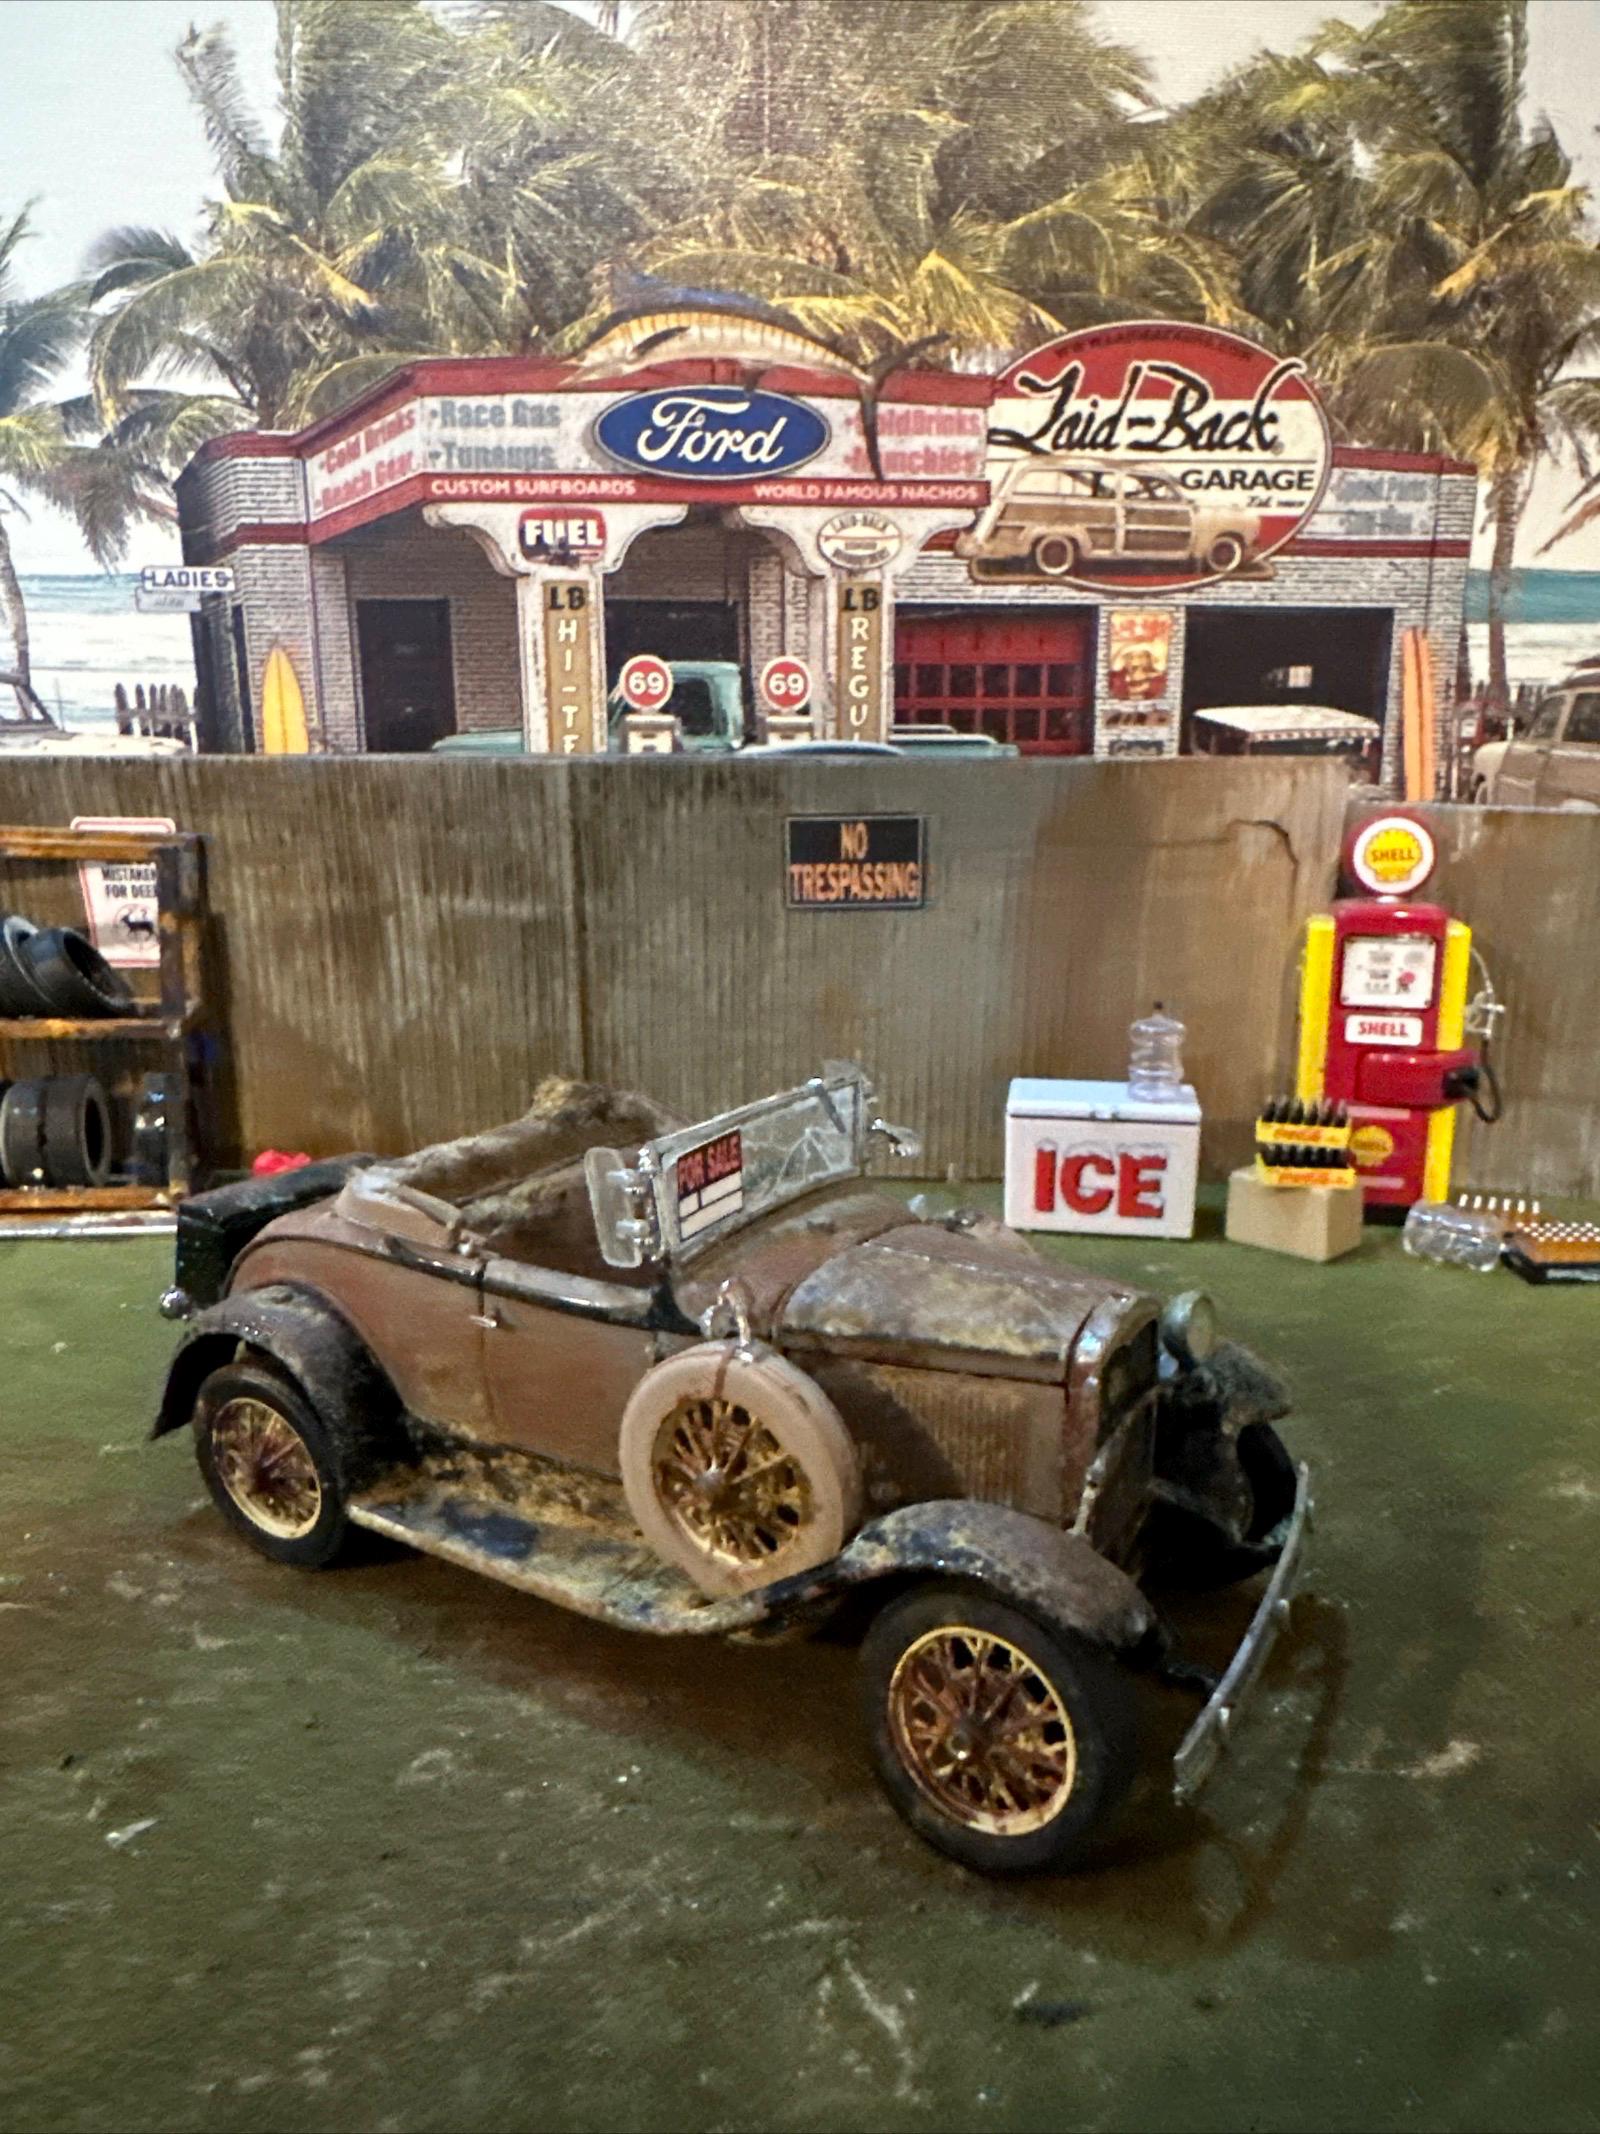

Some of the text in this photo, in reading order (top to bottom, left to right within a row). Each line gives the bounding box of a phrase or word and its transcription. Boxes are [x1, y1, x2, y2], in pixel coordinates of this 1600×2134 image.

[440, 398, 561, 428] Race Gas
[986, 361, 1305, 456] Laid-Back
[637, 397, 787, 464] Ford
[431, 479, 636, 496] CUSTOM SURFBOARDS
[753, 484, 979, 501] WORLD FAMOUS NACHOS
[1180, 469, 1315, 491] GARAGE
[523, 519, 603, 546] FUEL
[152, 571, 229, 588] LADIES
[548, 586, 586, 611] LB
[843, 587, 879, 612] LB
[628, 671, 665, 696] 69
[768, 672, 806, 697] 69
[849, 617, 870, 741] REGU
[840, 822, 869, 860] NO
[1371, 848, 1416, 863] SHELL
[105, 884, 128, 899] FOR
[790, 861, 921, 901] TRESPASSING
[1357, 1020, 1411, 1038] SHELL
[1034, 1141, 1168, 1218] ICE
